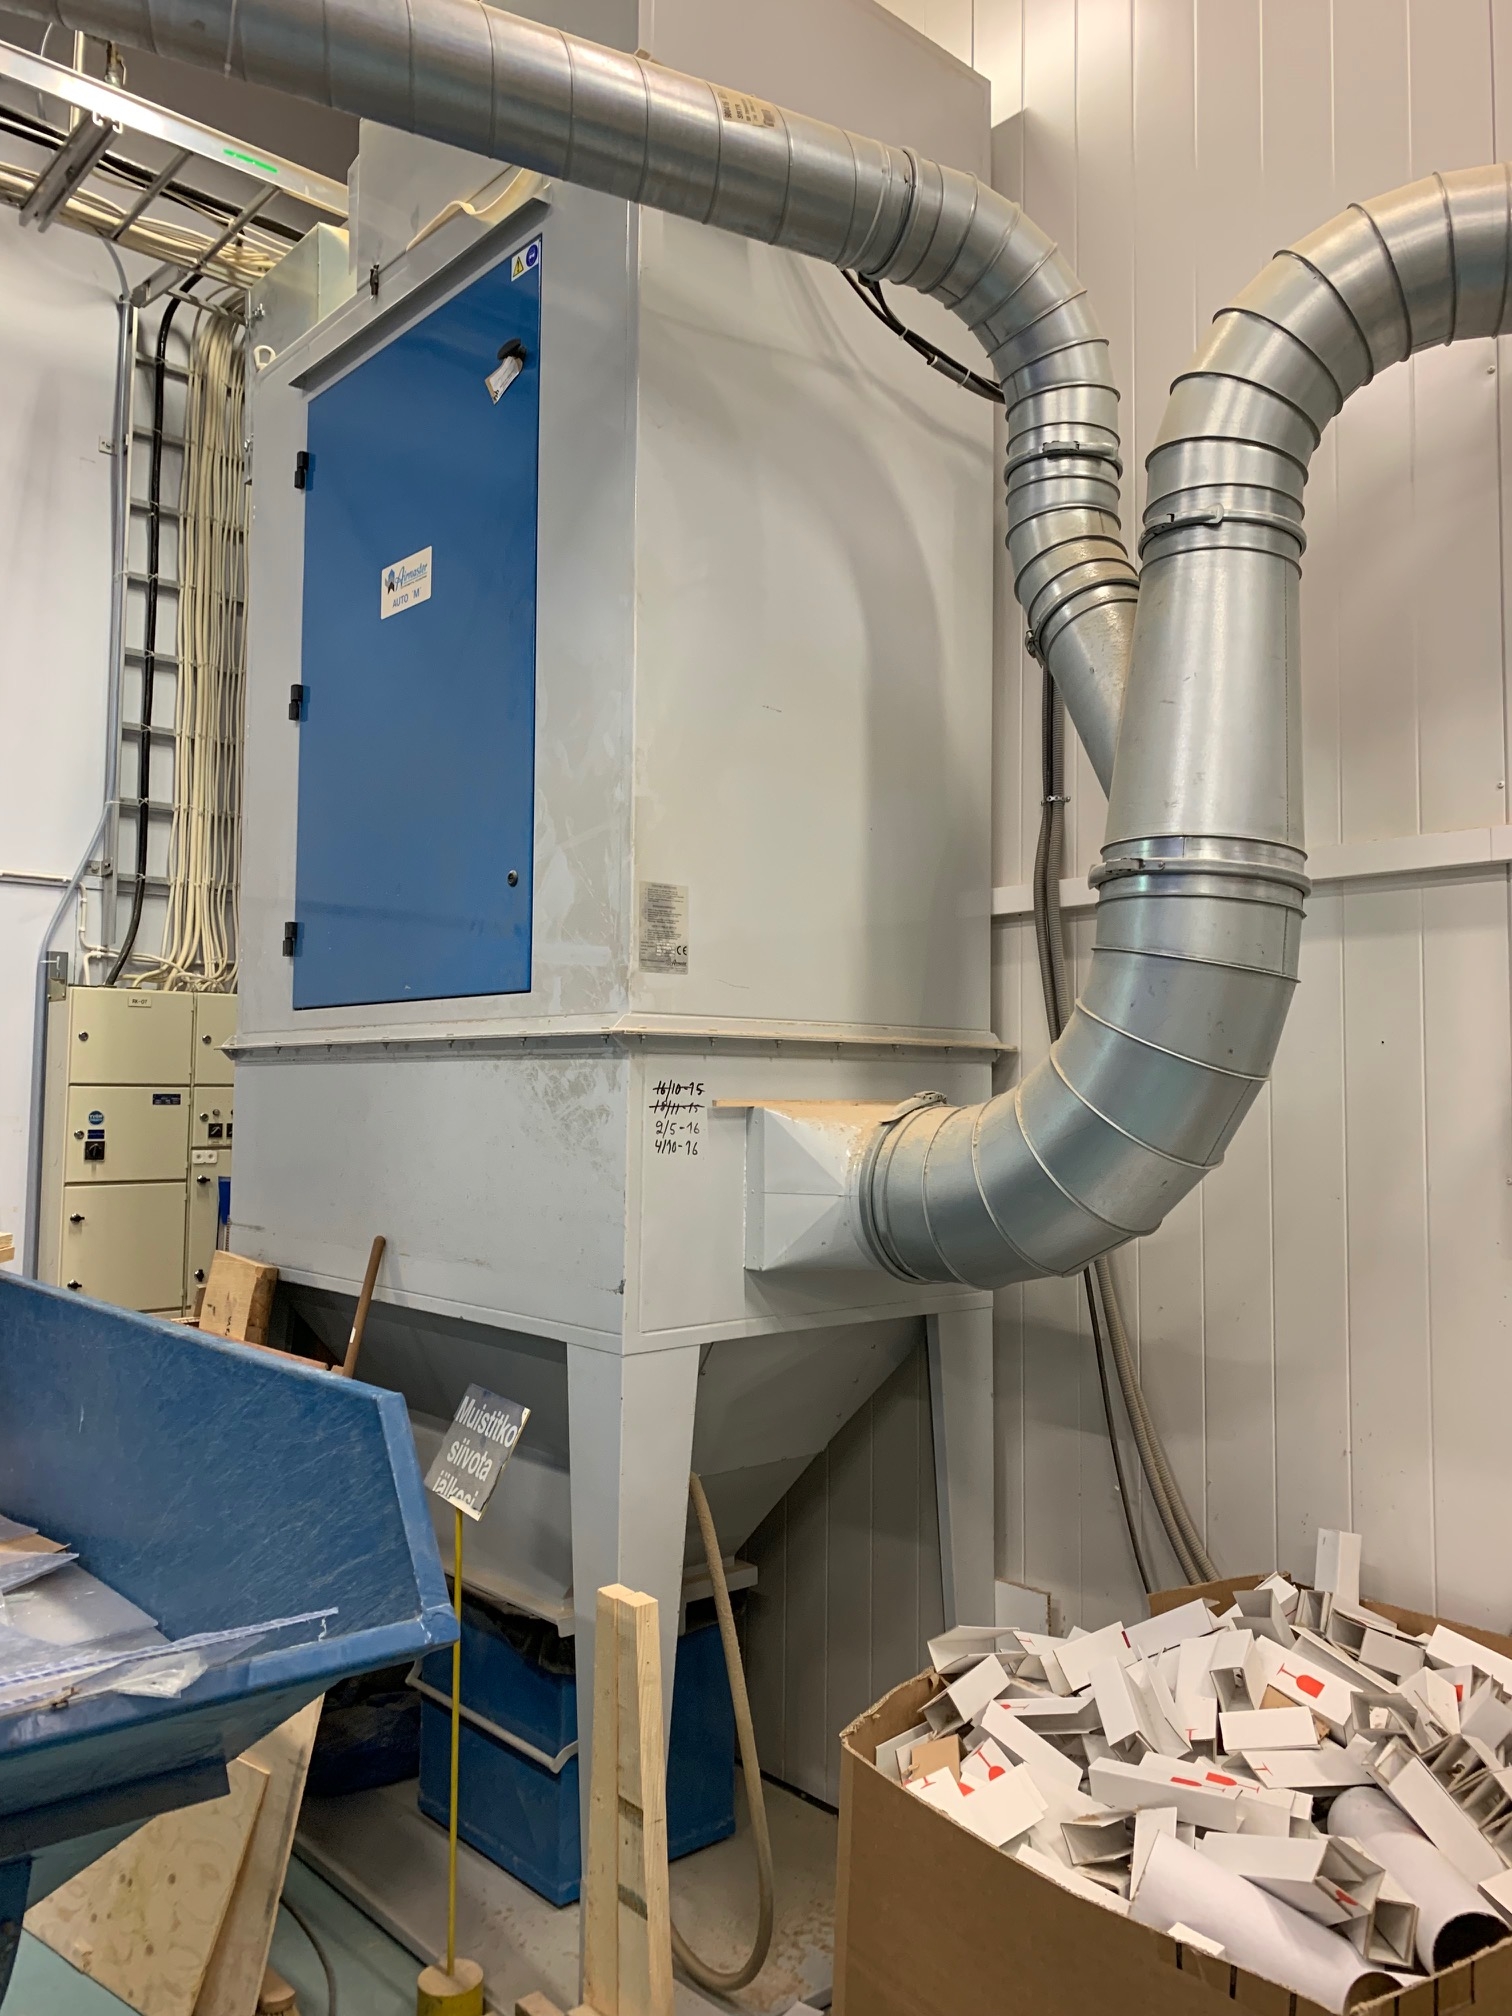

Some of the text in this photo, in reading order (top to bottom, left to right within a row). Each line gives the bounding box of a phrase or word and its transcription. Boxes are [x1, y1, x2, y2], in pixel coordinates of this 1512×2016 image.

[395, 563, 428, 591] Airmaster
[392, 593, 409, 608] AUTO
[455, 1395, 519, 1448] Muistitko
[446, 1437, 493, 1482] siivota
